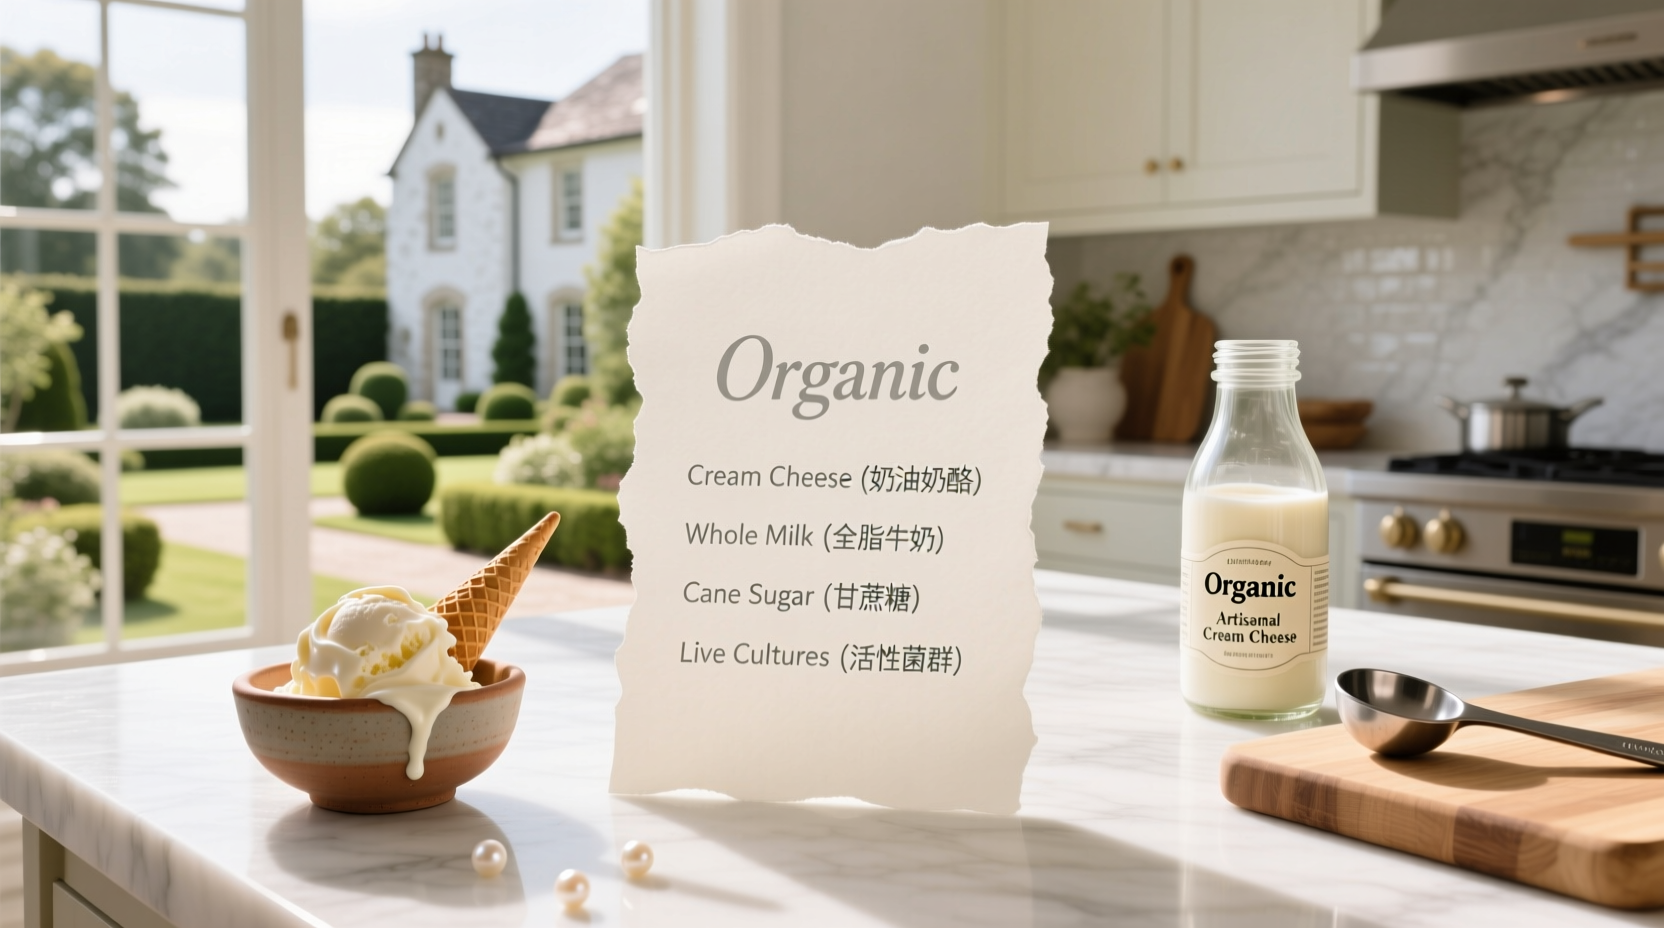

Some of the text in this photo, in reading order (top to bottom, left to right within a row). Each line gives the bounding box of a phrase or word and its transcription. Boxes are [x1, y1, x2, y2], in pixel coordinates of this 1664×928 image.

[716, 334, 960, 421] Organic
[687, 463, 982, 497] Cream Cheese (奶油奶酪)
[685, 521, 944, 555] Whole Milk (全脂牛奶)
[683, 580, 920, 615] Cane Sugar (甘蔗糖)
[1204, 571, 1297, 605] Organic
[1202, 626, 1298, 644] Cream Cheese
[680, 641, 962, 677] Live Cultures (活性菌群)
